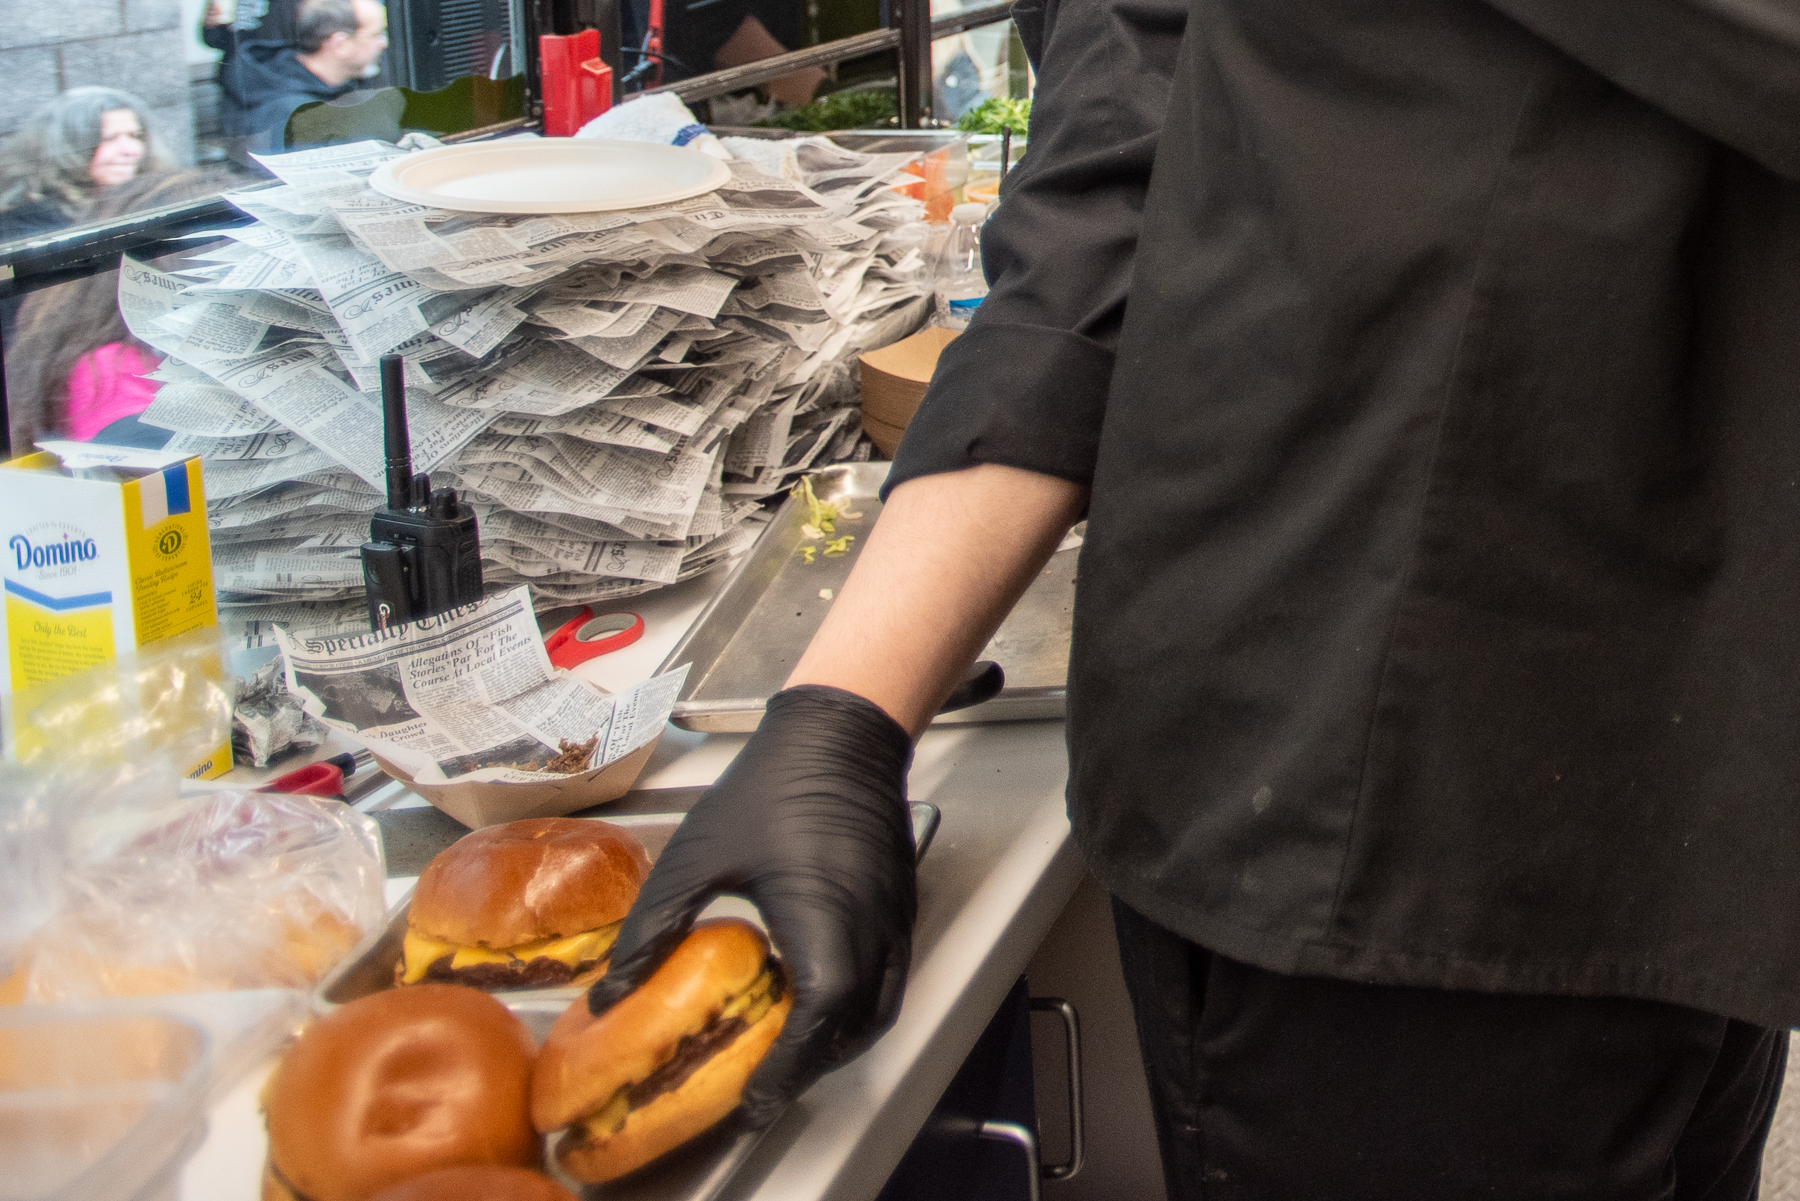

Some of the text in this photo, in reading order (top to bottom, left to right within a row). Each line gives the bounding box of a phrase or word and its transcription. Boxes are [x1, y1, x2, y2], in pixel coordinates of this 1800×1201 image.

[443, 408, 468, 428] ourse
[9, 533, 97, 570] Domino
[38, 566, 77, 580] Since 1901
[189, 590, 202, 604] 24
[34, 621, 88, 638] Only the Best
[408, 647, 462, 670] Allegatins
[466, 637, 482, 650] Of
[453, 652, 472, 667] Par
[476, 644, 495, 658] For
[499, 633, 518, 647] The
[412, 636, 532, 689] Course At Local Events
[380, 721, 428, 739] Daughter
[390, 728, 425, 743] Crowd
